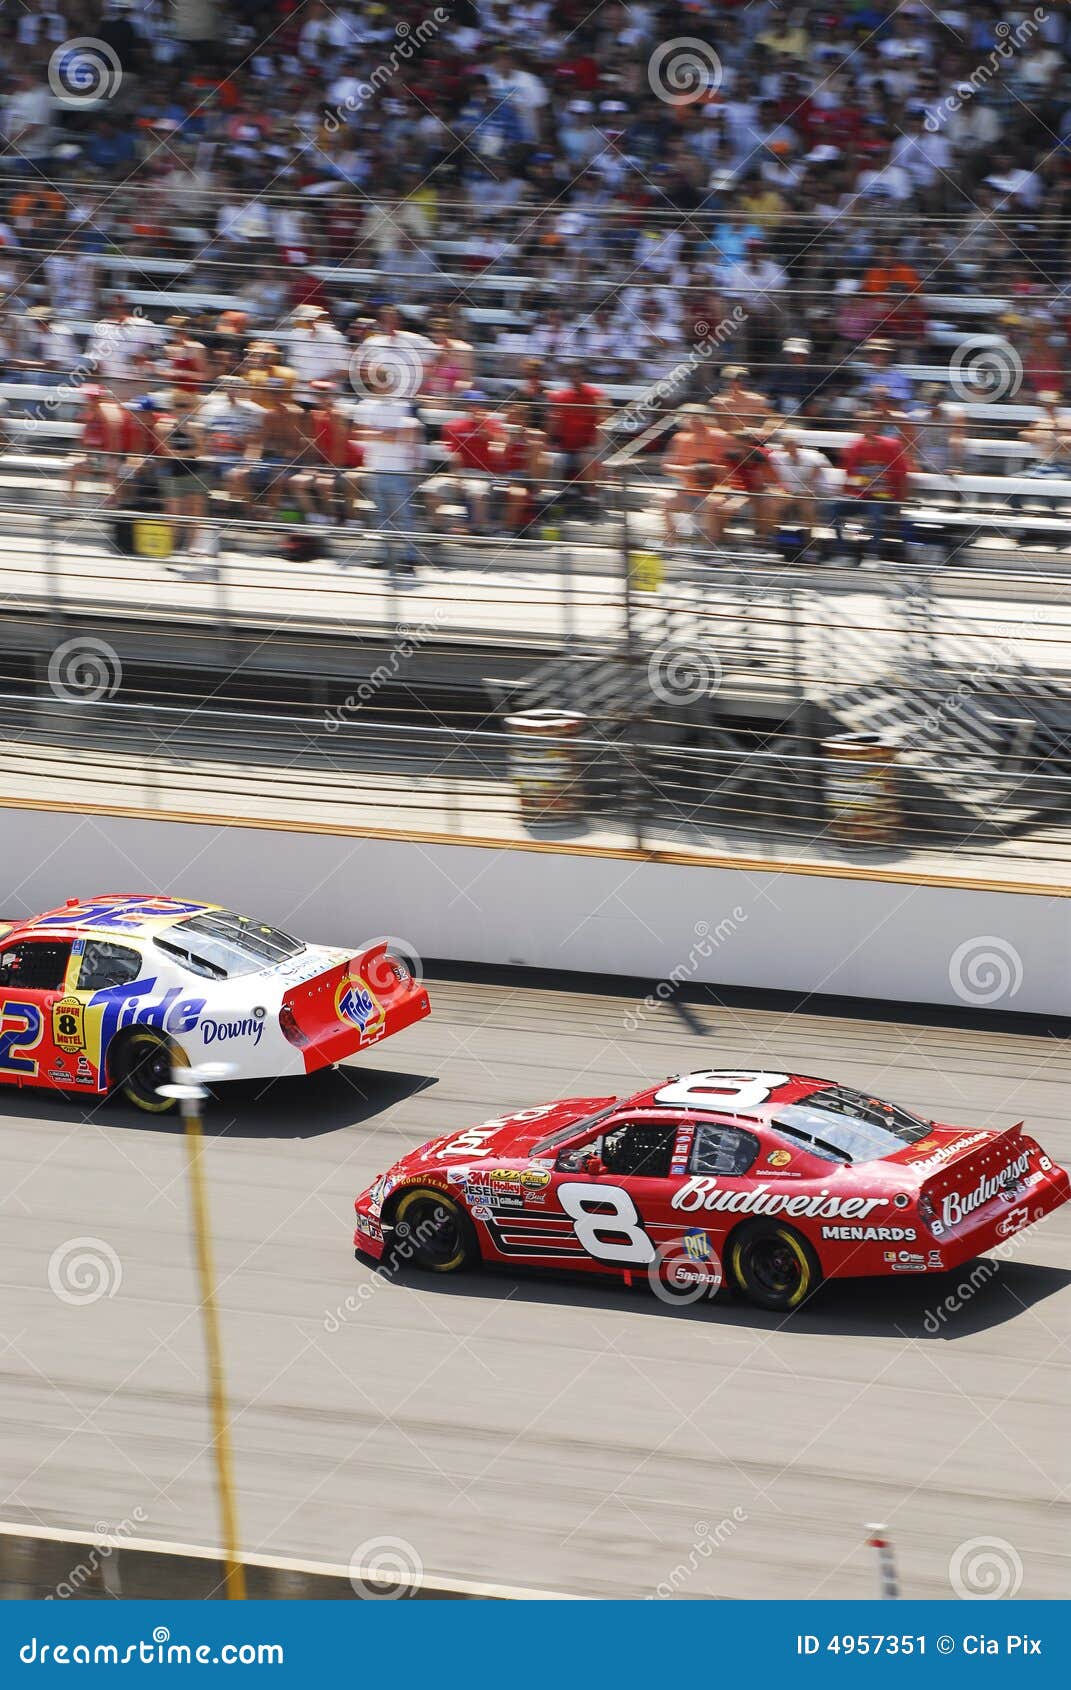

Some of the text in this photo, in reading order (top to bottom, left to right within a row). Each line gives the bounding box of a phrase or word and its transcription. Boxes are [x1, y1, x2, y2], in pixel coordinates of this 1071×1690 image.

[56, 1005, 79, 1018] SUPER
[339, 987, 374, 1032] Tide
[58, 1014, 77, 1035] 8
[200, 1016, 264, 1047] Downy
[0, 1001, 43, 1075] 2
[56, 1034, 82, 1046] MOTEL
[1039, 1156, 1053, 1171] 8
[468, 1172, 490, 1186] 3M
[941, 1149, 1034, 1227] Budweiser
[671, 1175, 889, 1219] Budweiser
[557, 1182, 656, 1265] 8
[821, 1226, 917, 1241] MENARDS
[930, 1219, 944, 1236] 8
